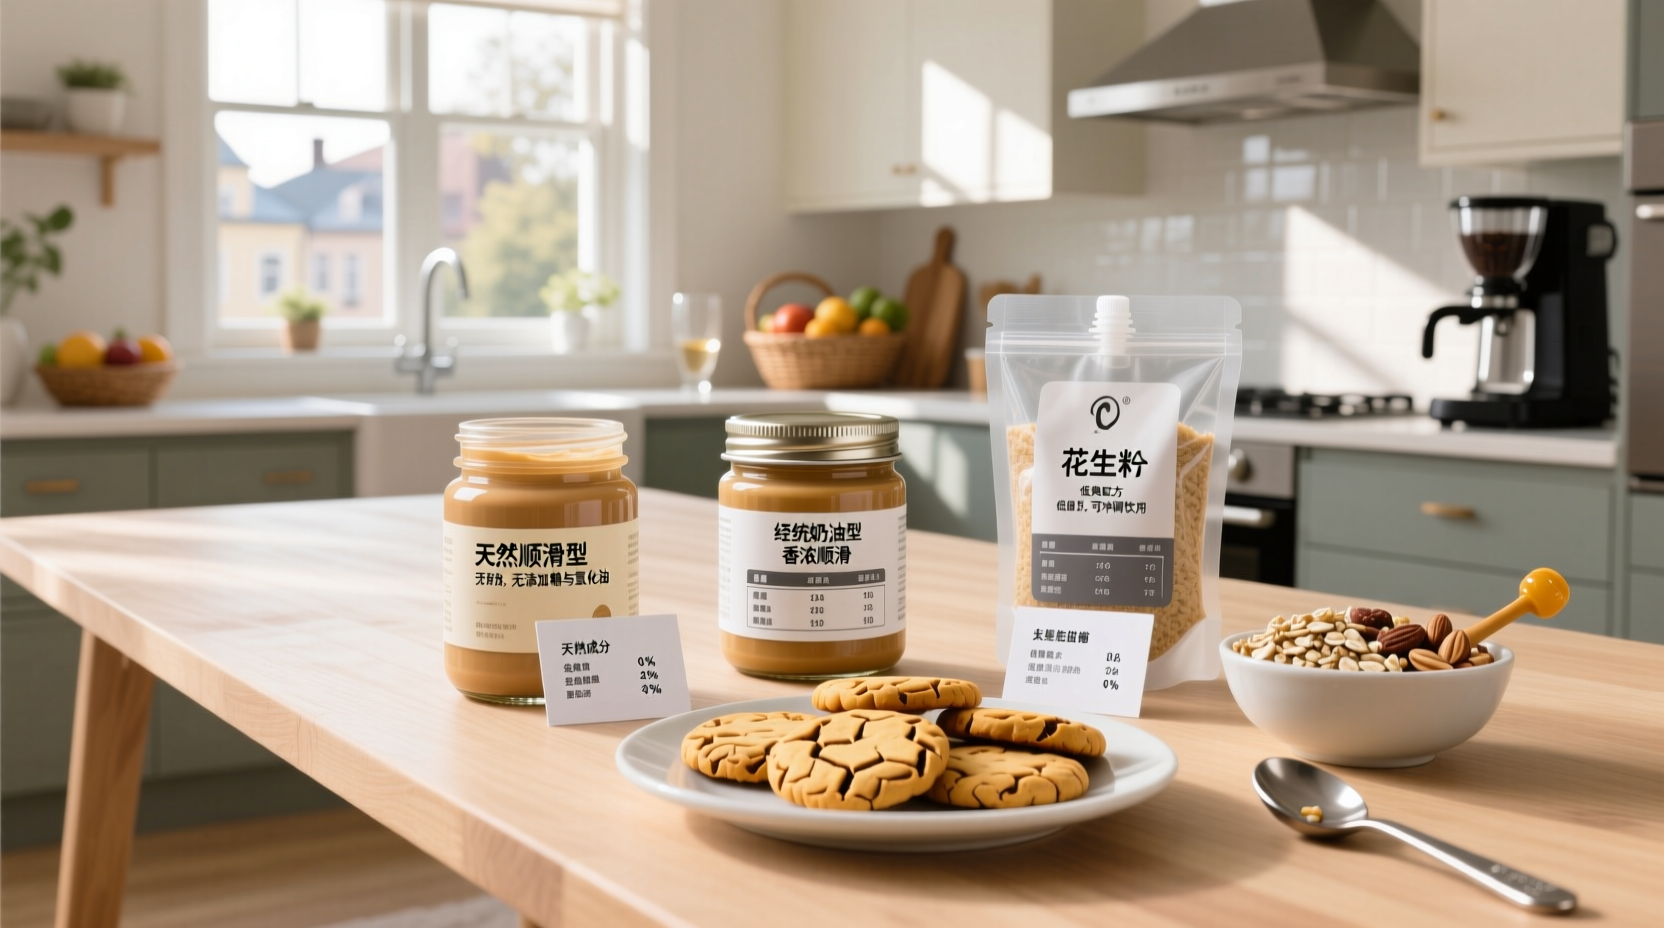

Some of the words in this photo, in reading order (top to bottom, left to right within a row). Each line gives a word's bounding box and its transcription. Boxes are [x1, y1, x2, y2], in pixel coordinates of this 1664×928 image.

[475, 541, 588, 568] 天然顺滑型
[782, 545, 852, 565] 香浓顺滑
[1103, 679, 1119, 690] 0%
